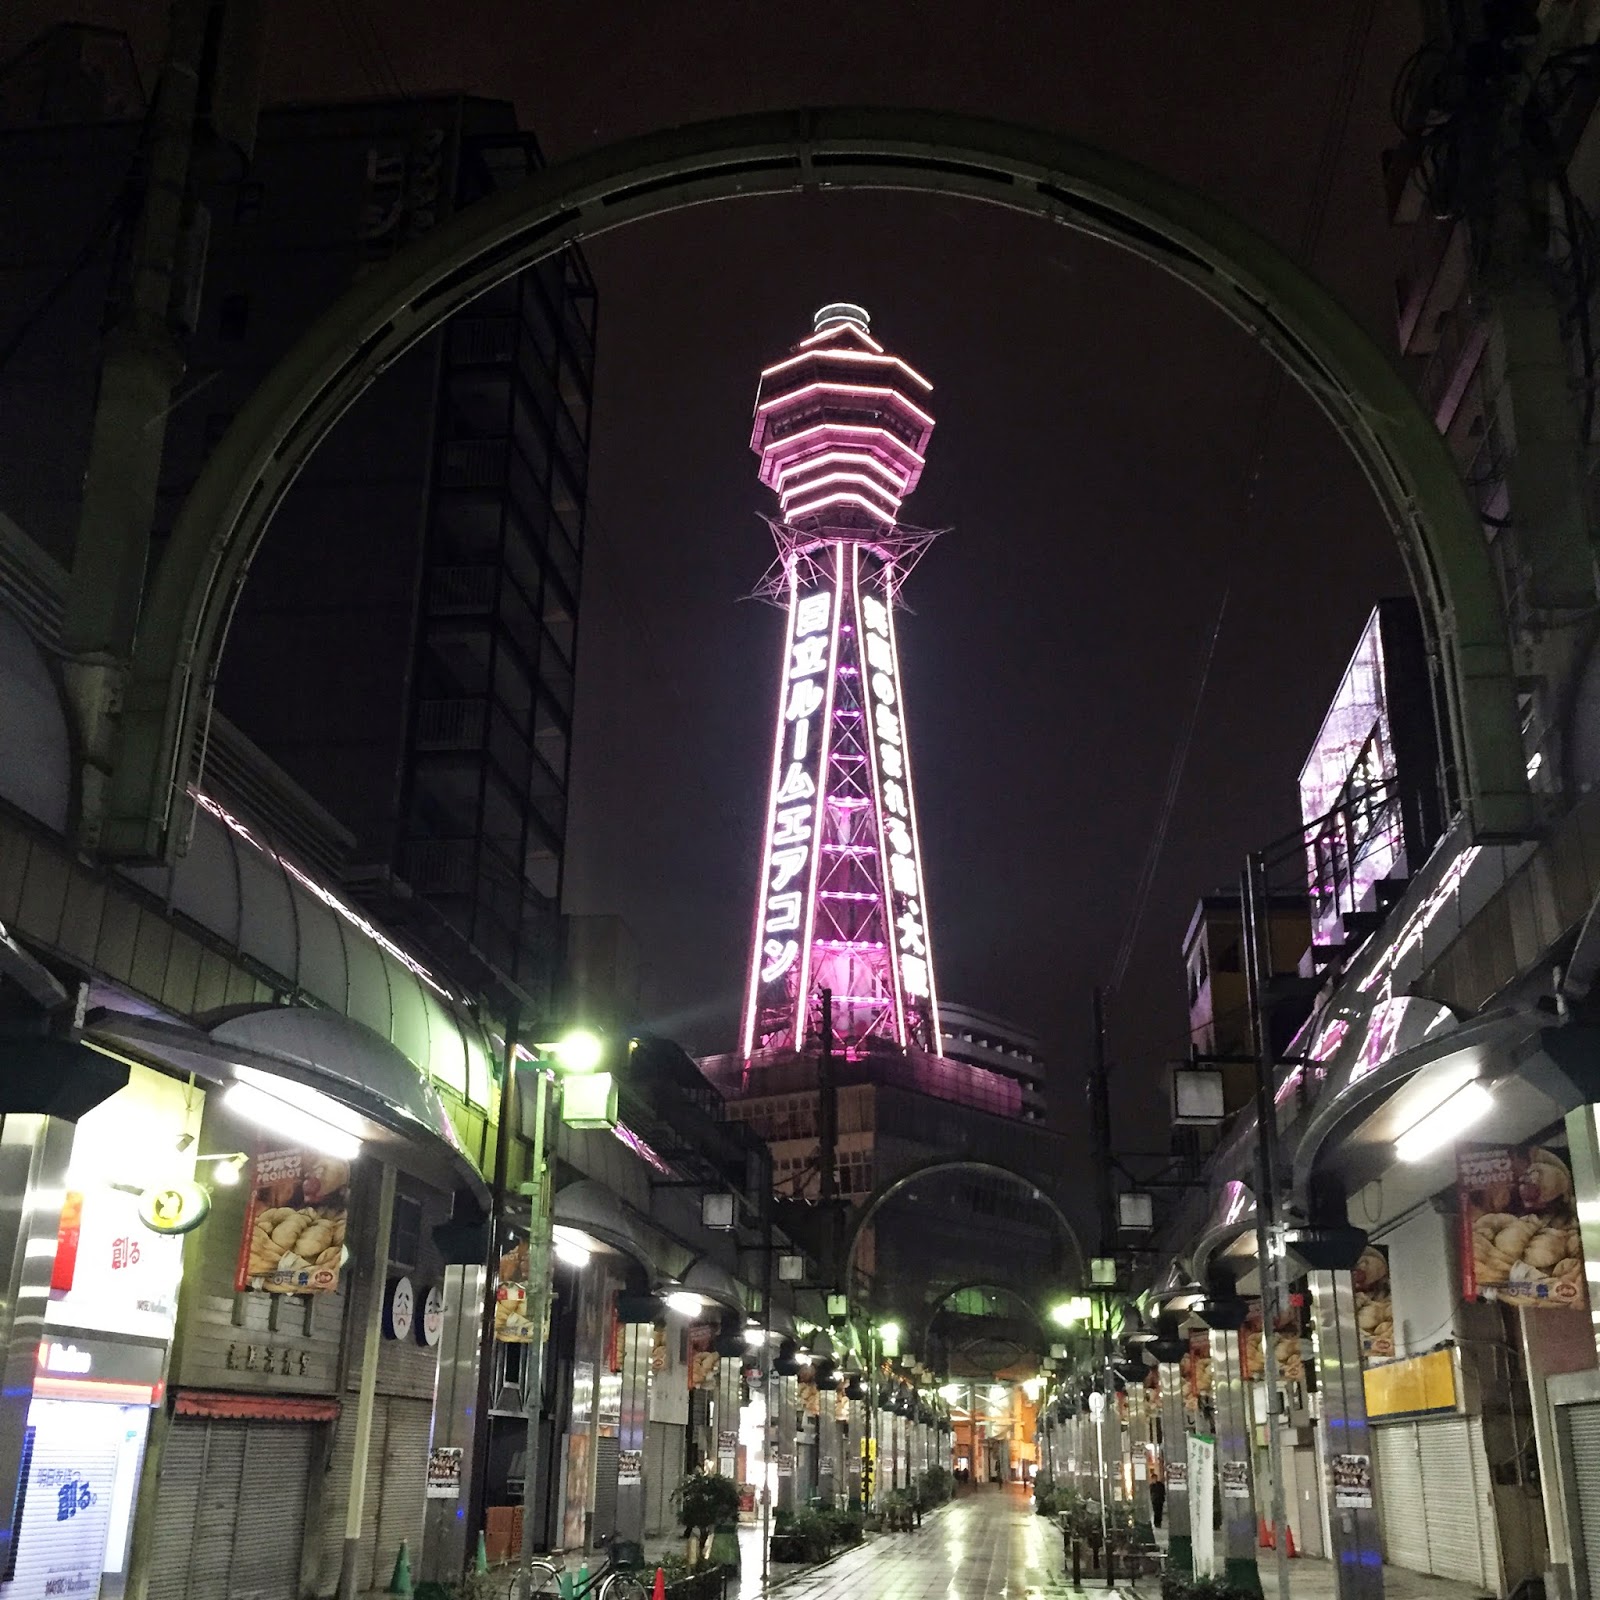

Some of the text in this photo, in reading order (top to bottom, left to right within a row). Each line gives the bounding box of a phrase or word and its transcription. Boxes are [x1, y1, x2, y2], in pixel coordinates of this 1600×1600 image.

[761, 592, 831, 983] 日立ルームエアコン
